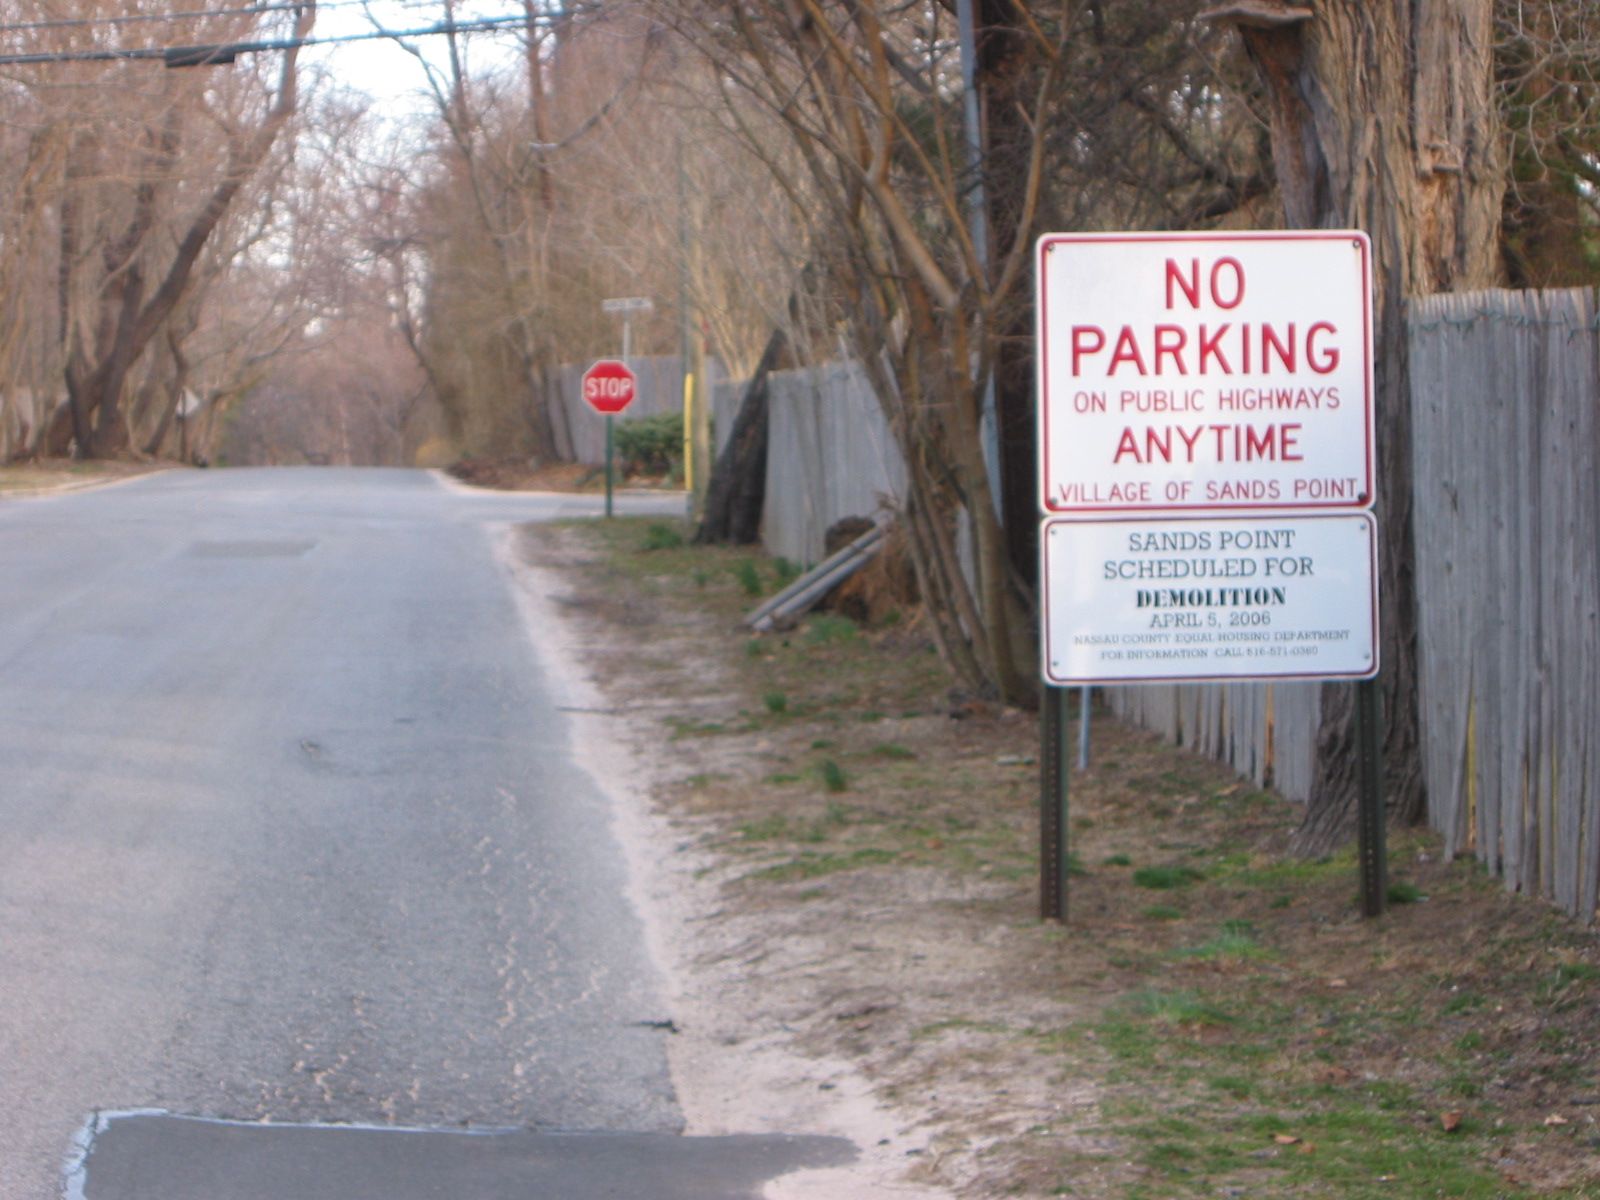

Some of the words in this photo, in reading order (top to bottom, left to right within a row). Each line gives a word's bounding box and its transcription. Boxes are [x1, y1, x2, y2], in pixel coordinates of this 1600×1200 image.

[1165, 256, 1246, 310] NO
[1071, 321, 1340, 377] PARKING
[586, 377, 632, 397] STOP
[1074, 391, 1107, 413] ON
[1120, 389, 1205, 412] PUBLIC
[1218, 387, 1340, 410] HIGHWAYS
[1113, 423, 1304, 464] ANYTIME
[1059, 482, 1152, 502] VILLAGE
[1165, 481, 1193, 500] OF
[1206, 480, 1281, 500] SANDS
[1294, 478, 1358, 499] POINT
[1129, 531, 1211, 552] SANDS
[1219, 529, 1296, 550] POINT
[1104, 559, 1257, 580] SCHEDULED
[1264, 556, 1314, 577] FOR
[1136, 587, 1286, 608] DEMOLITION
[1150, 613, 1203, 629] APRIL
[1208, 612, 1223, 629] 5,
[1229, 611, 1272, 626] 2006
[1074, 634, 1119, 645] NASSAU
[1122, 632, 1170, 644] COUNTY
[1175, 631, 1213, 643] EQUAL
[1217, 630, 1271, 642] HOUSING
[1274, 629, 1350, 641] DEPARTMENT
[1101, 649, 1123, 660] FOR
[1127, 647, 1208, 659] INFORMATION
[1214, 646, 1244, 657] CALL
